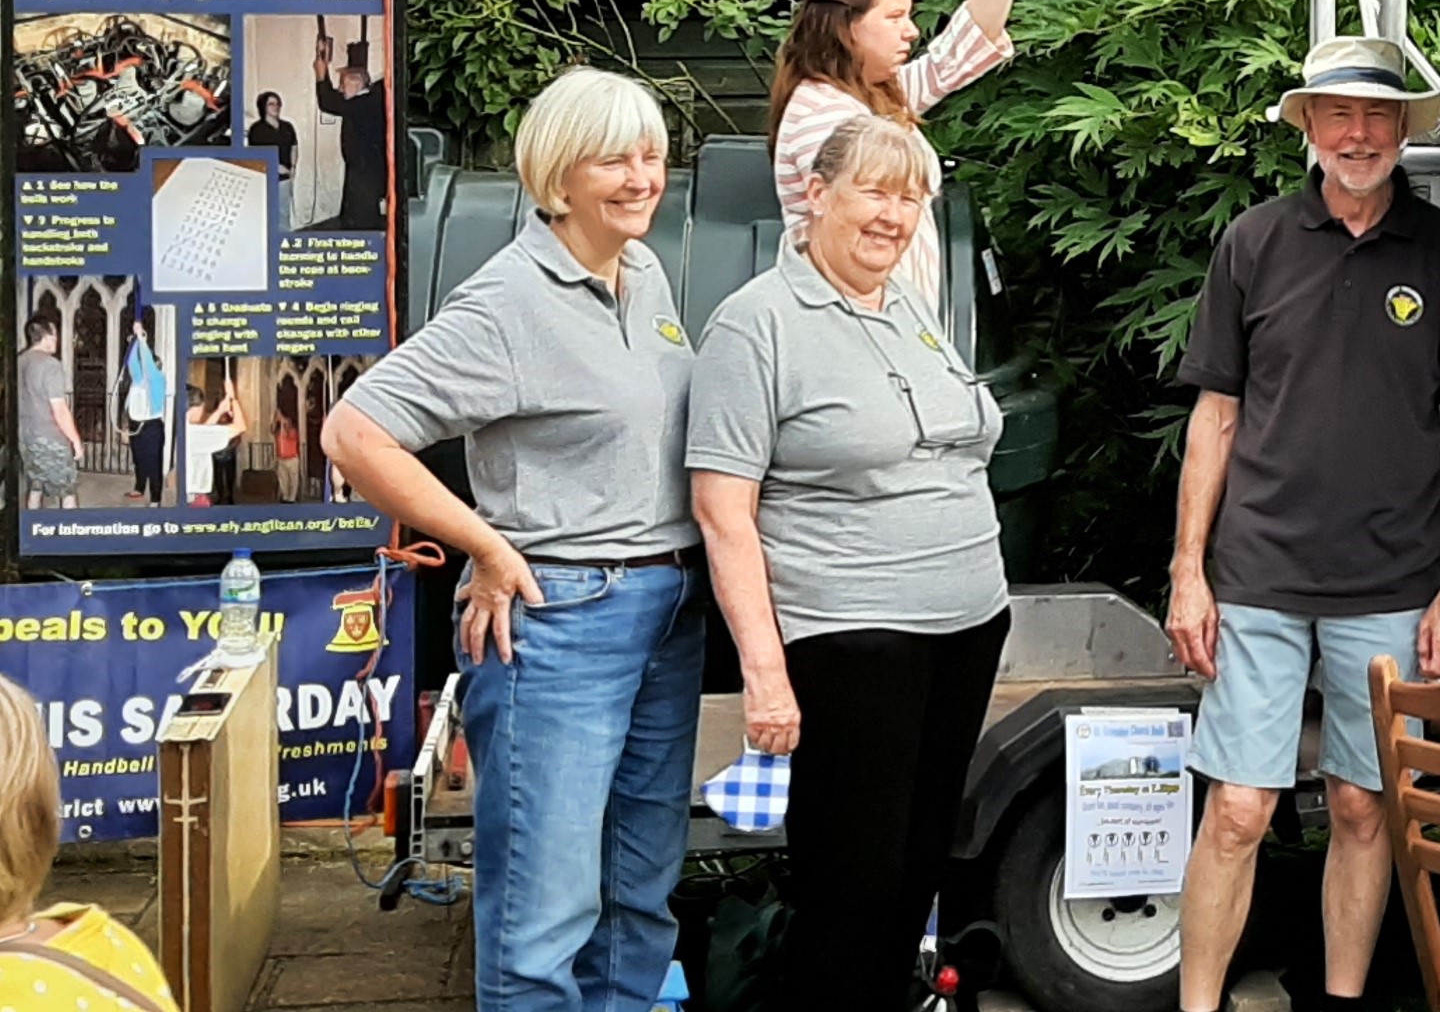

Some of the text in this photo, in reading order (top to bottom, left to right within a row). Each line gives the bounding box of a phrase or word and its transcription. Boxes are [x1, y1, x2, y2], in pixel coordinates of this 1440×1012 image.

[32, 523, 56, 536] For
[59, 522, 140, 536] information
[143, 523, 161, 537] go
[164, 521, 179, 534] to
[121, 611, 165, 641] to
[63, 755, 156, 777] Handbell
